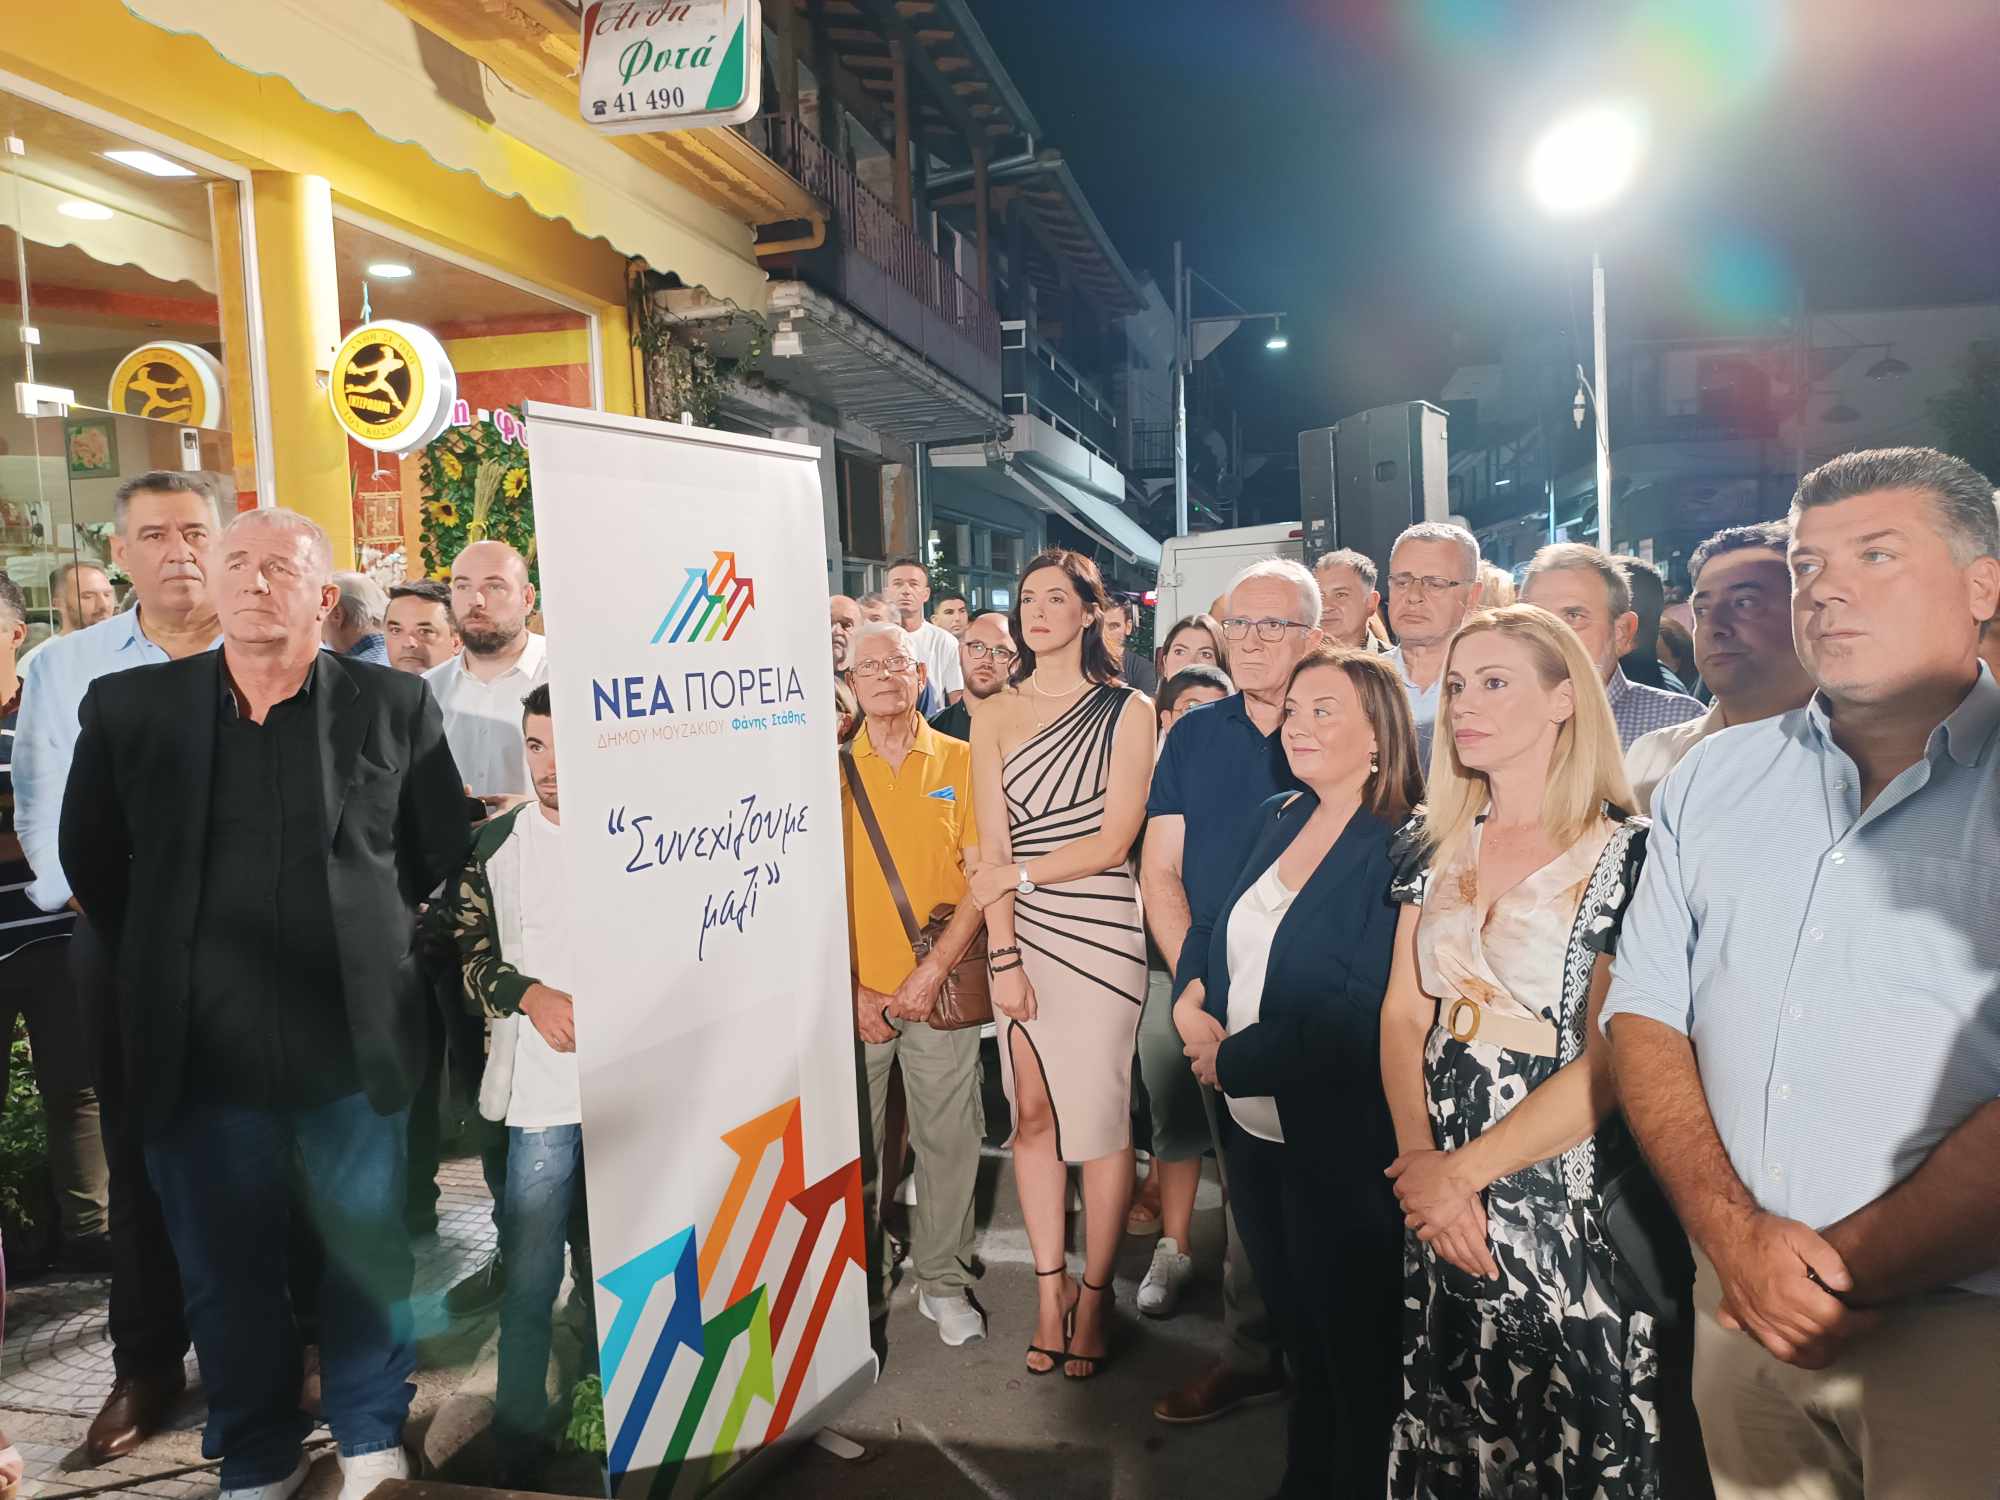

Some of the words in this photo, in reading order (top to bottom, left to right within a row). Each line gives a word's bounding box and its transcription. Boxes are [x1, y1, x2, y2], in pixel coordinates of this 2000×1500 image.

[613, 91, 637, 113] 41
[645, 86, 685, 111] 490
[591, 673, 675, 722] ΝΕΑ
[684, 665, 805, 712] ΠΟΡΕΙΑ
[597, 729, 648, 749] ΔΗΜΟΥ
[651, 719, 725, 742] ΜΟΥΖΑΚΙΟΥ
